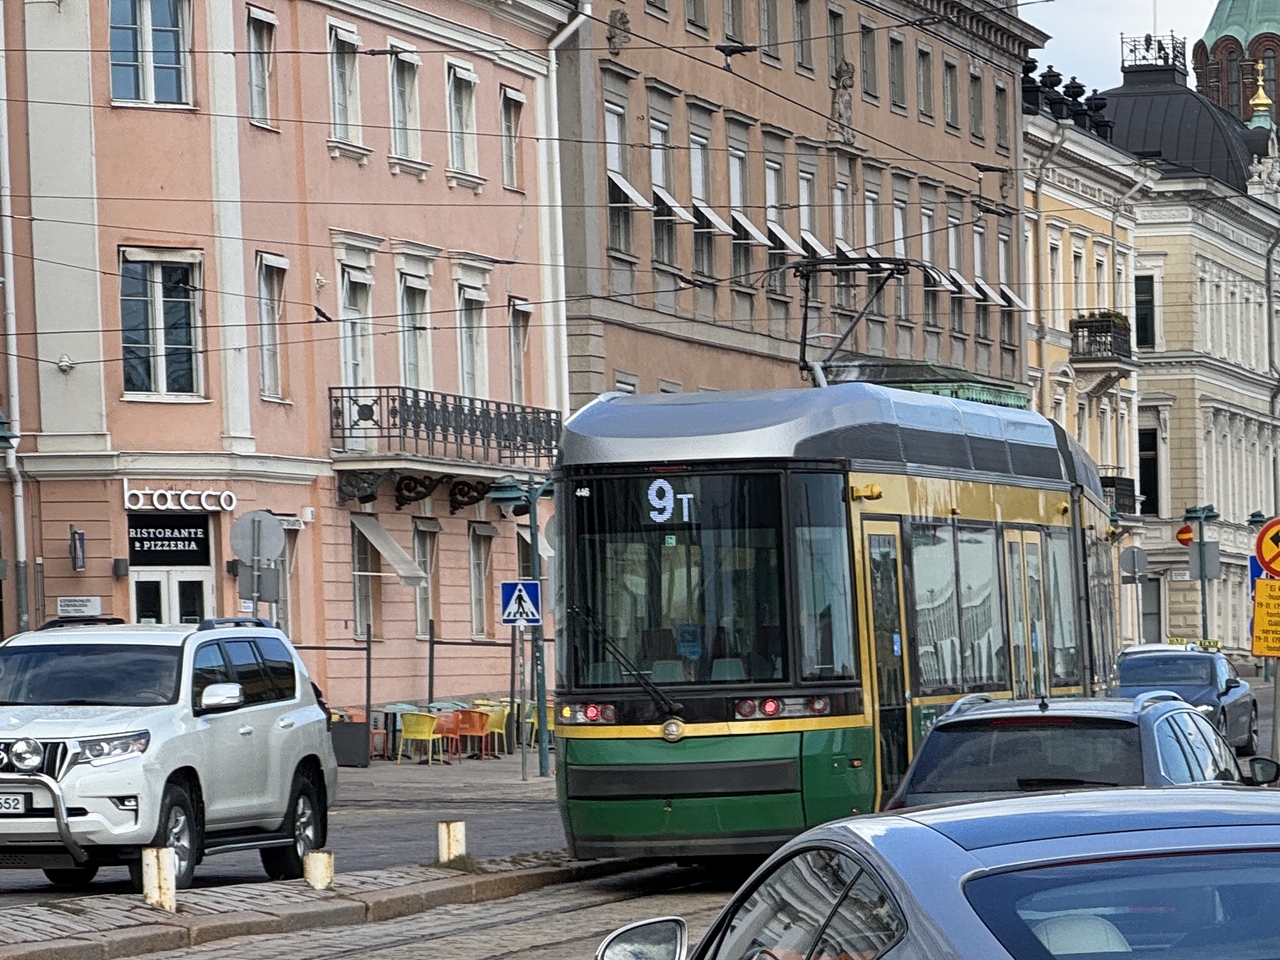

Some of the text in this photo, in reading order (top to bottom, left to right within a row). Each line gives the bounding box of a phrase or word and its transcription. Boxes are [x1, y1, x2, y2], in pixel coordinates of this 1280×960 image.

[122, 478, 237, 511] bacco
[129, 528, 204, 538] RISTORANTE
[143, 541, 198, 551] PIZZERIA
[0, 798, 20, 810] 52
